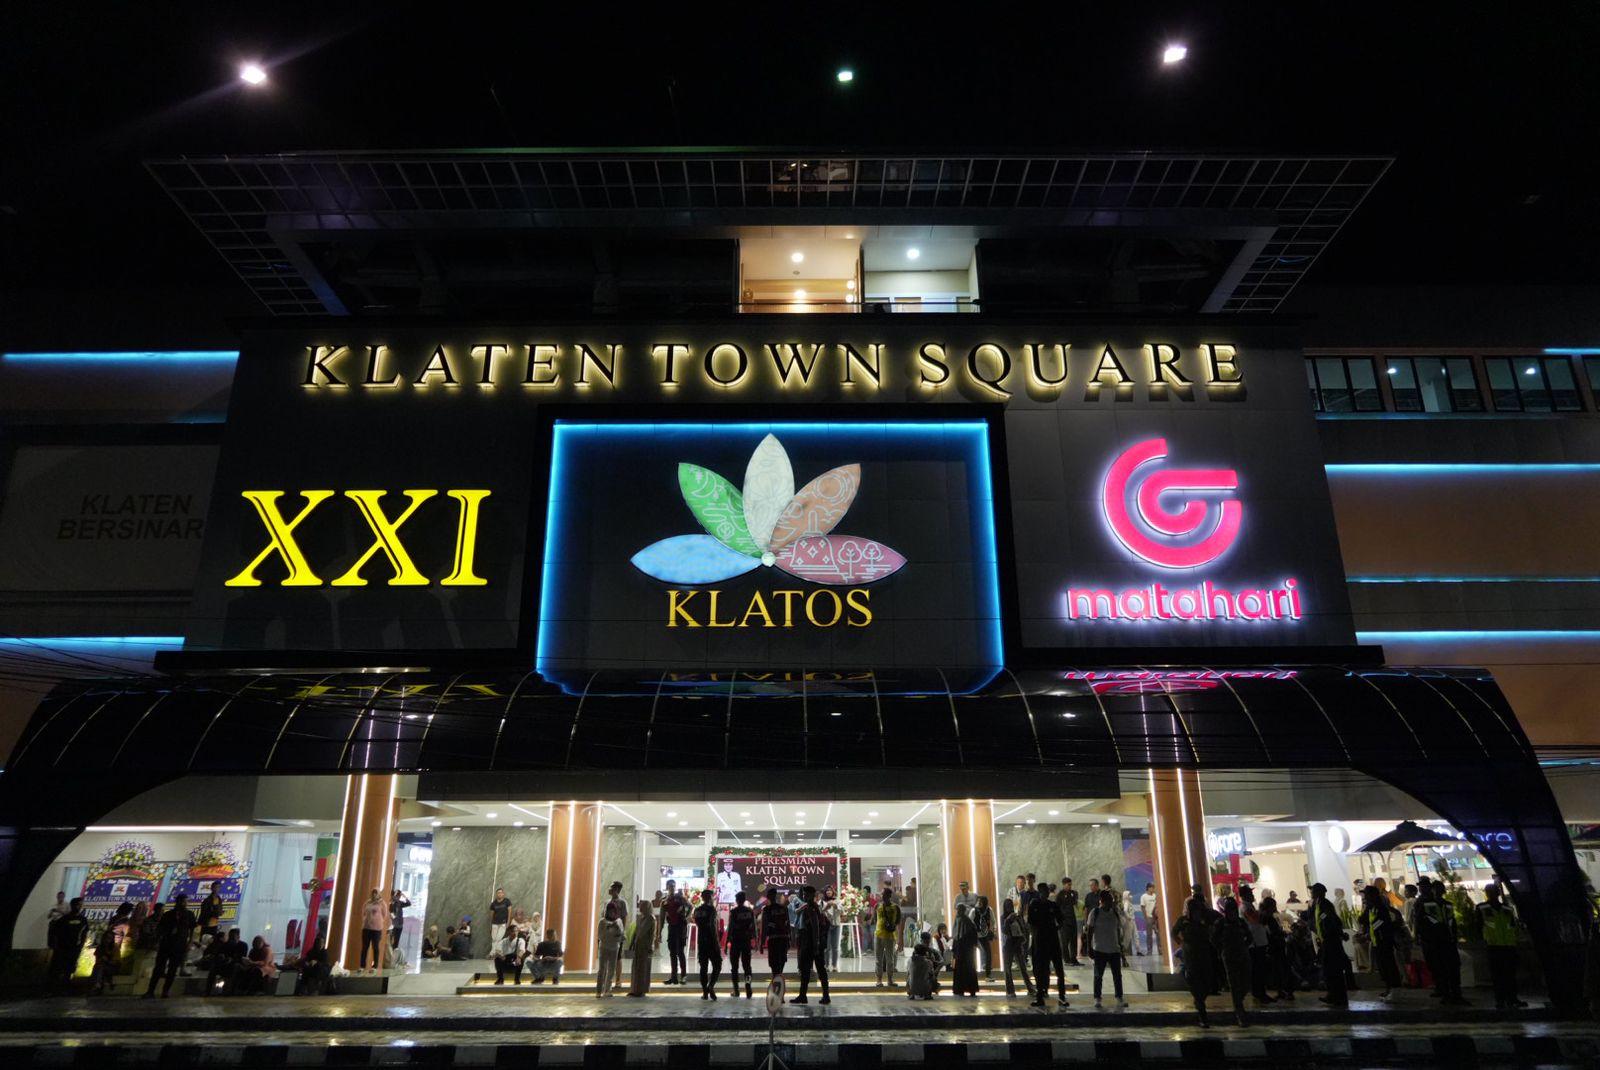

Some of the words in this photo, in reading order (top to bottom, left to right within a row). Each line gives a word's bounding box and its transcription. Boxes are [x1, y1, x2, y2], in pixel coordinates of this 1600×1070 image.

[302, 343, 622, 391] KLATEN
[651, 343, 886, 391] TOWN
[918, 342, 1245, 400] SQUARE
[80, 494, 193, 515] KLATEN
[57, 518, 203, 540] BERSINAR
[224, 489, 492, 587] XXI
[665, 588, 873, 628] KLATOS
[1066, 577, 1302, 622] matahari
[745, 866, 787, 875] KLATEN
[790, 865, 825, 875] TOWN
[754, 857, 816, 865] PERESMIAN
[763, 876, 807, 886] SQUARE
